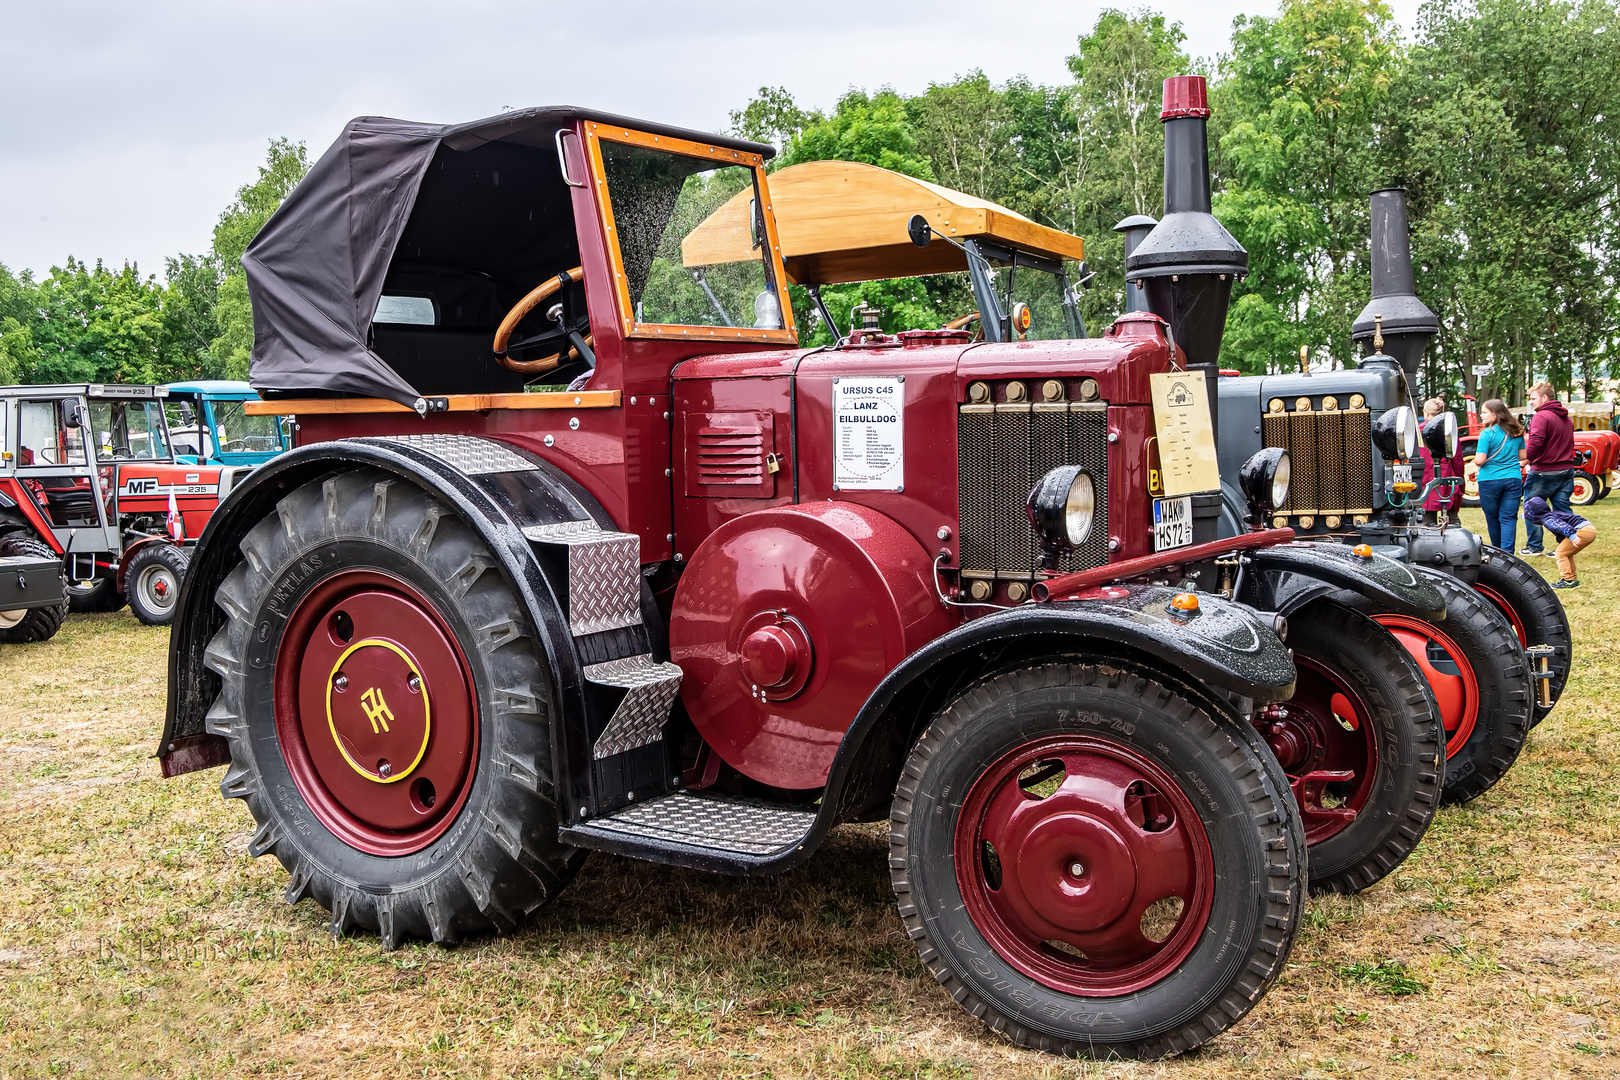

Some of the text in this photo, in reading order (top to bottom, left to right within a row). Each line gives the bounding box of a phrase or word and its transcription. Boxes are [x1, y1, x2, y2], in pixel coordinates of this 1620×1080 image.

[842, 386, 893, 395] URSUS C45
[854, 402, 878, 410] LANZ
[839, 415, 897, 423] EILBULLDOG
[128, 481, 156, 494] MF
[1161, 500, 1179, 524] WAK
[266, 553, 324, 616] PETLAS
[1056, 709, 1136, 736] 7.50-20
[950, 930, 1099, 1027] DEBICA
